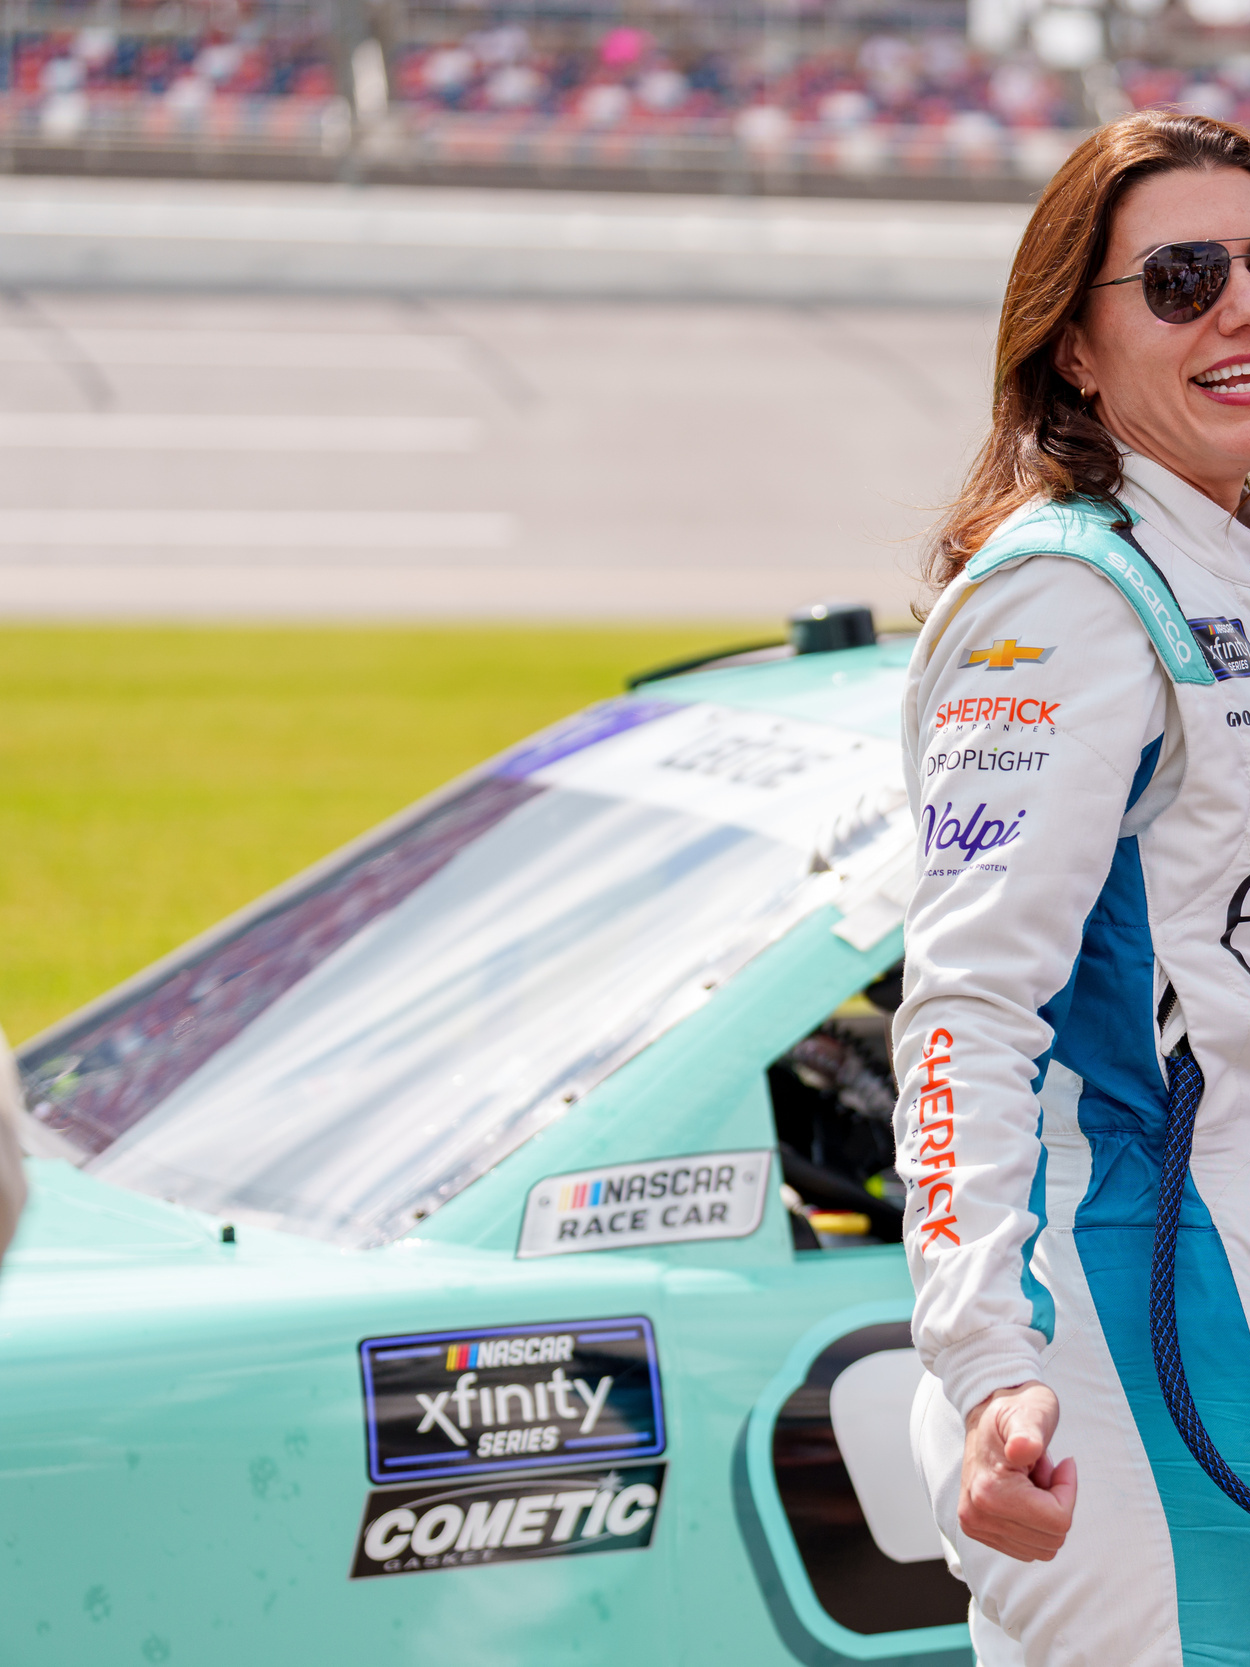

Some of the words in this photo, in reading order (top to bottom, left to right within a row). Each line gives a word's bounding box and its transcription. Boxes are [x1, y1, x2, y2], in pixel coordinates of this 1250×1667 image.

[1105, 551, 1192, 667] sparco
[1228, 660, 1249, 671] SERIES
[935, 697, 1062, 729] SHERFICK
[921, 801, 1026, 862] Volpi
[975, 863, 1008, 872] PROTEIN
[917, 1028, 961, 1254] SHERFICK
[602, 1165, 736, 1203] NASCAR
[557, 1208, 648, 1241] RACE
[660, 1202, 730, 1229] CAR
[476, 1335, 574, 1368] NASCAR
[415, 1367, 614, 1447] xfinity
[477, 1426, 560, 1458] SERIES
[364, 1483, 657, 1561] COMETIC
